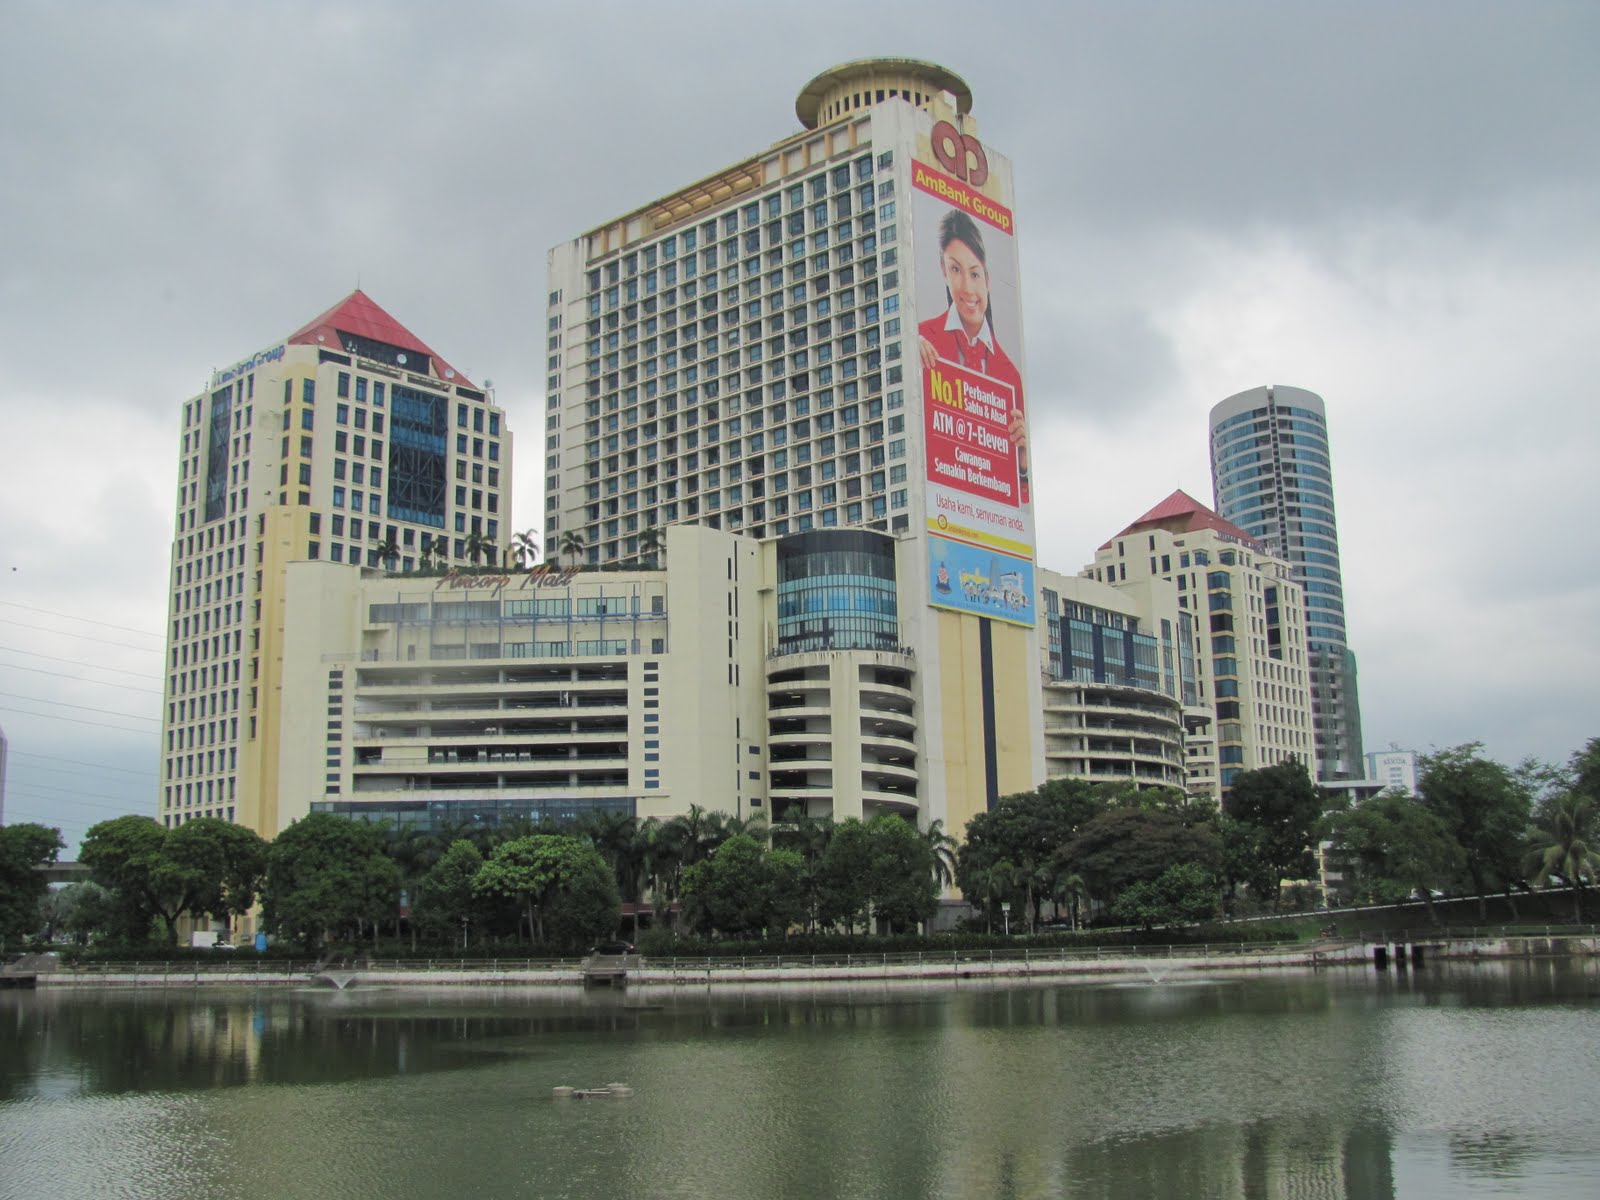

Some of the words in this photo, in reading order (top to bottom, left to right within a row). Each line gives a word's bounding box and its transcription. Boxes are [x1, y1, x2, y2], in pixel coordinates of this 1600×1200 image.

[916, 169, 970, 208] AmBank
[973, 197, 1010, 229] Group
[930, 368, 963, 409] No.1
[963, 381, 1006, 410] Perbankan
[964, 398, 983, 417] Sabtu
[984, 405, 990, 419] &
[991, 408, 1007, 425] Ahad
[933, 410, 954, 436] ATM
[956, 419, 965, 439] @
[967, 422, 1009, 455] 7-Eleven
[955, 447, 991, 471] Cawangan
[934, 457, 966, 480] Semakin
[967, 468, 1011, 497] Berkembang
[936, 493, 956, 513] Usaha
[976, 507, 1007, 526] senyuman
[435, 567, 510, 598] Amcorp
[520, 565, 581, 590] Mall
